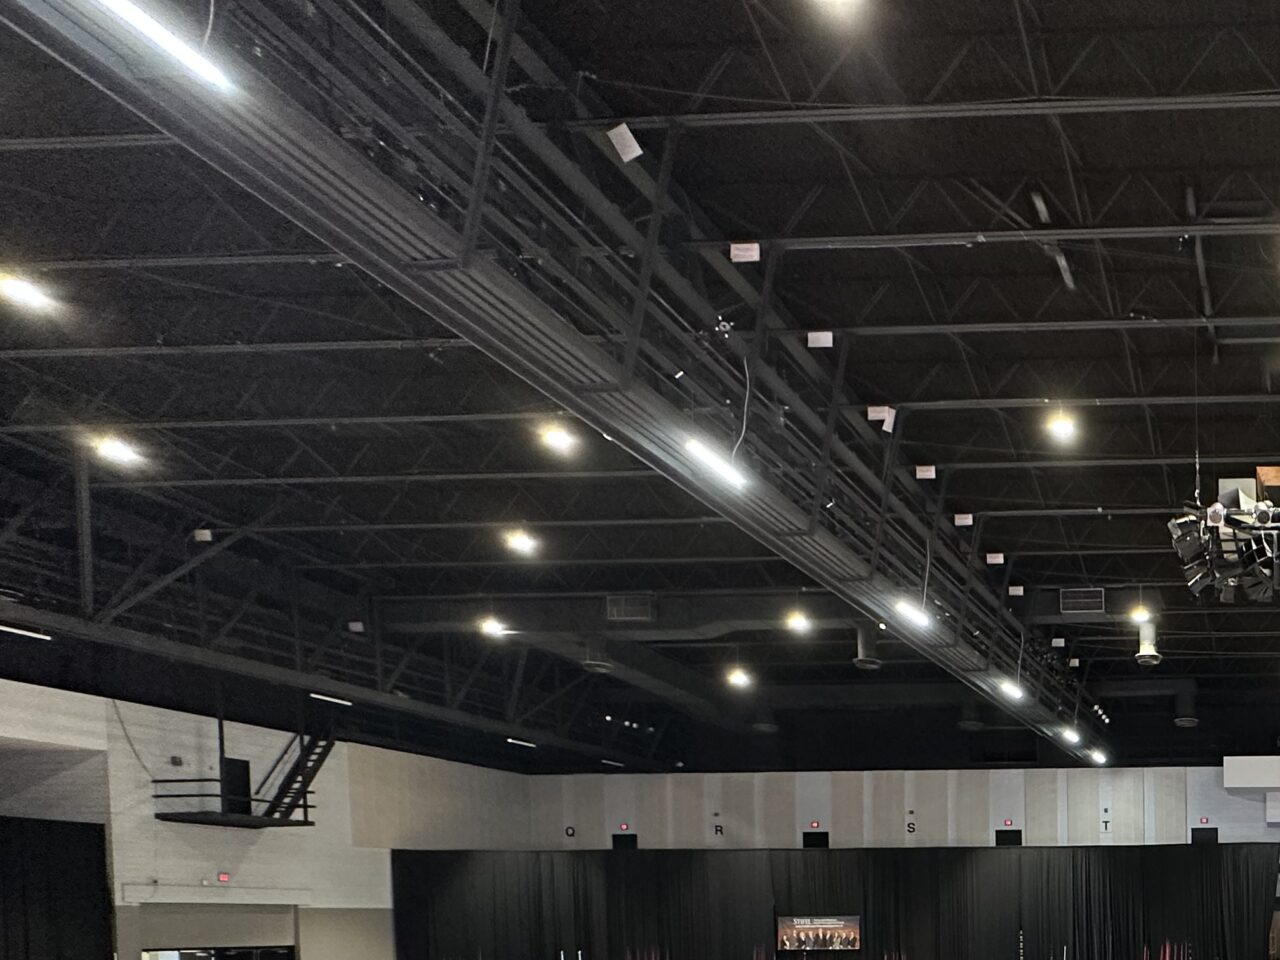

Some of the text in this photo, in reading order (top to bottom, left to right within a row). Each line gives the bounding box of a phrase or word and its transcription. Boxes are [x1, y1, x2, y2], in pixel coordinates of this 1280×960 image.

[714, 824, 724, 835] R
[906, 822, 915, 833] S
[1102, 820, 1110, 831] T
[565, 826, 575, 837] Q
